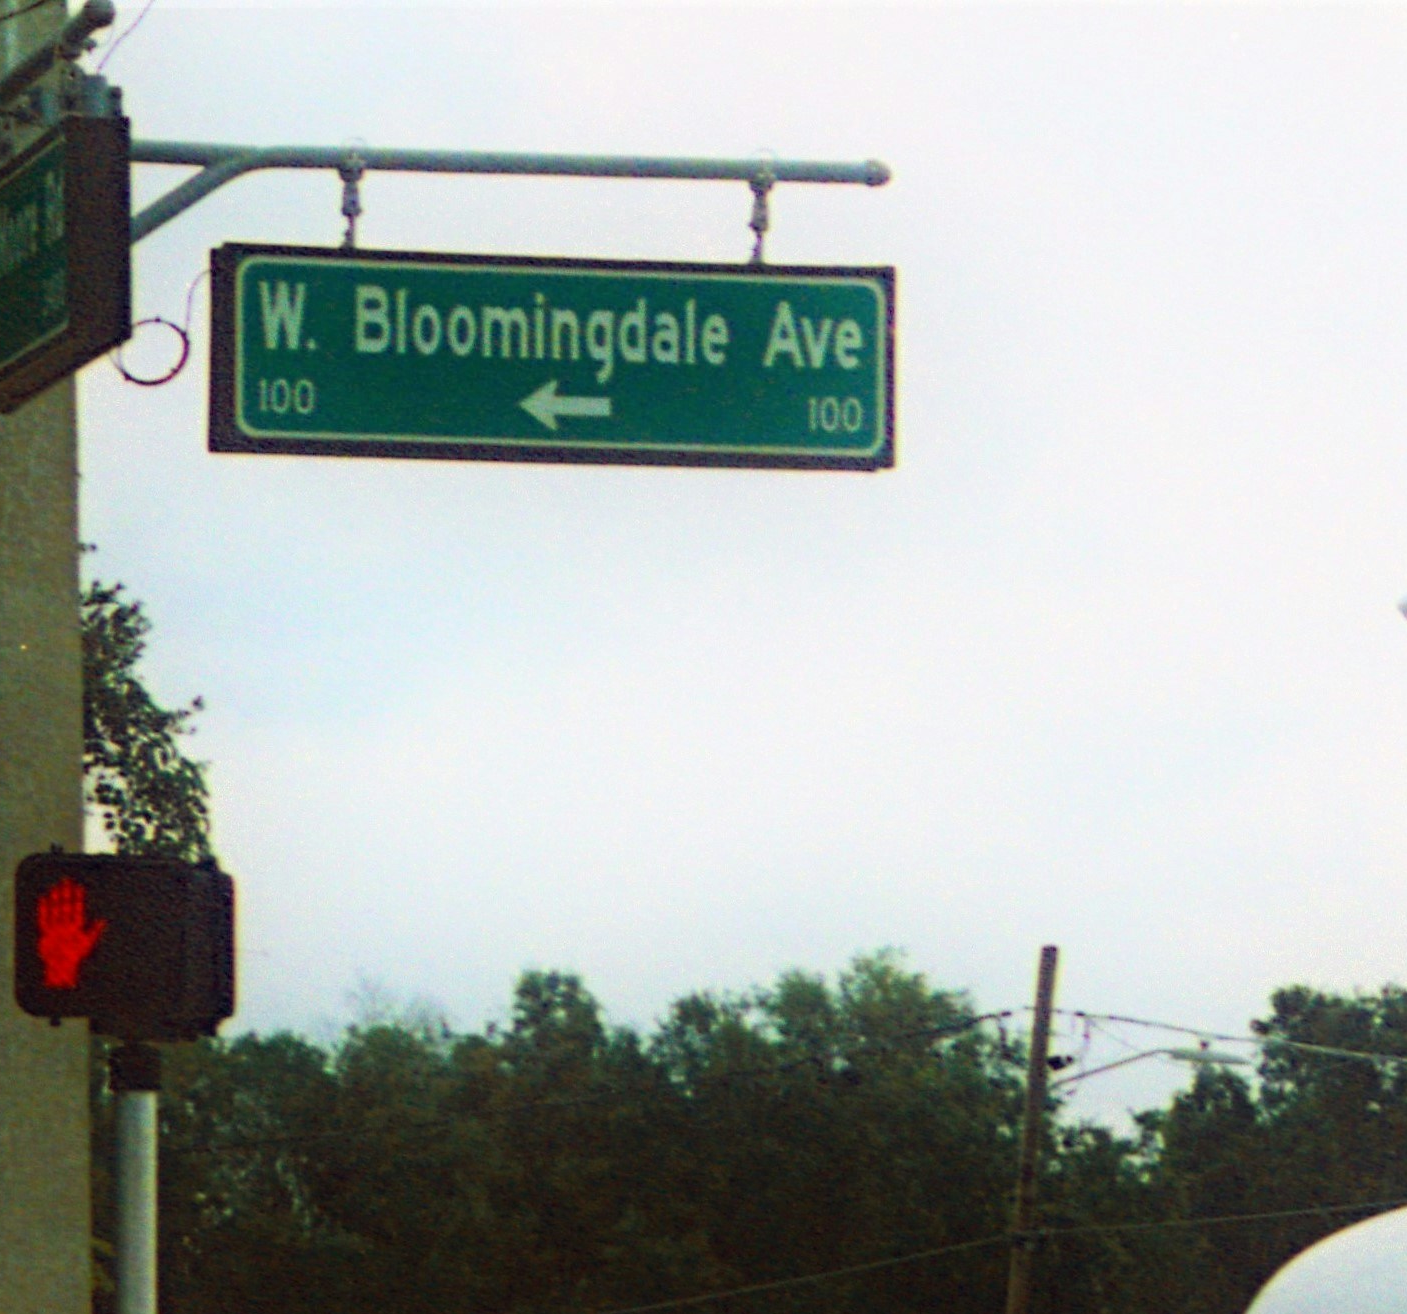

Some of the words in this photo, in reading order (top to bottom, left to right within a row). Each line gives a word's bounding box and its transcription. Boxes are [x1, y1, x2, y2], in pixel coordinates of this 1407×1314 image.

[258, 280, 317, 351] W.
[355, 284, 730, 384] Bloomingdale
[762, 301, 864, 370] Ave
[258, 378, 315, 415] 100
[806, 397, 864, 433] 100
